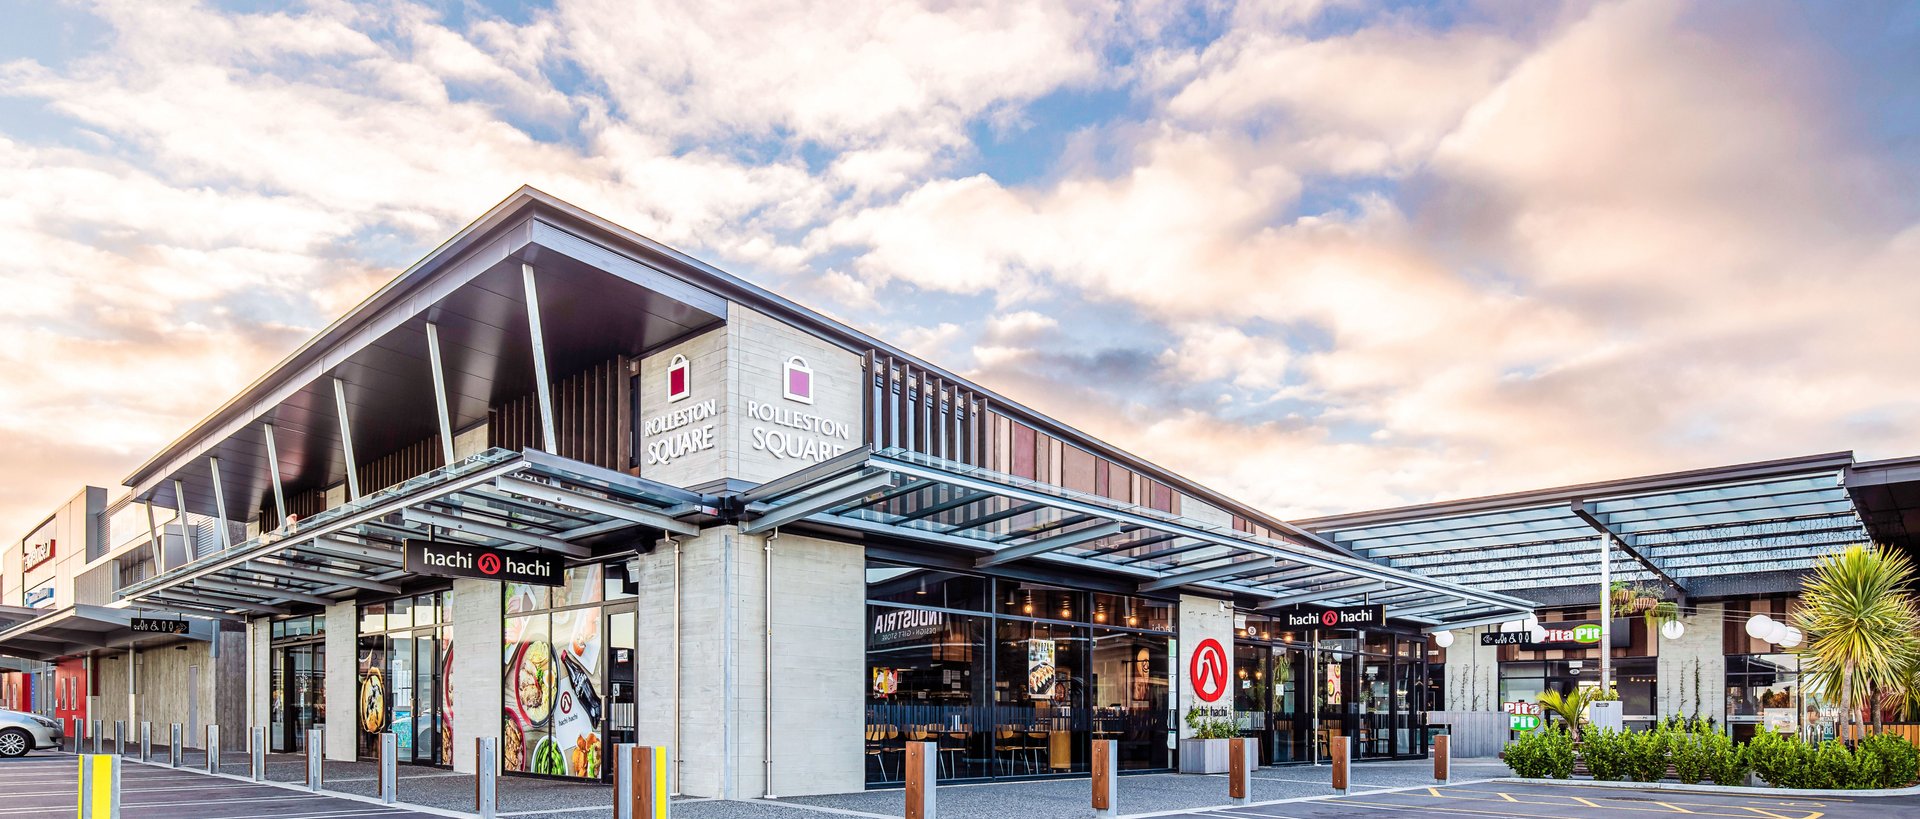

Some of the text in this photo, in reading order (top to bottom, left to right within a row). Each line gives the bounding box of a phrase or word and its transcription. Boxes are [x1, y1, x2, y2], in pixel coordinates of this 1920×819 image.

[645, 399, 717, 438] ROLLESTON
[747, 400, 849, 440] ROLLESTON
[647, 424, 714, 465] SQUARE
[423, 547, 550, 577] hachi hachi
[1289, 609, 1373, 626] hachi hachi
[1575, 628, 1600, 640] Pit
[1210, 706, 1227, 717] hachi
[1503, 702, 1540, 714] Pita
[1510, 715, 1535, 728] Pit
